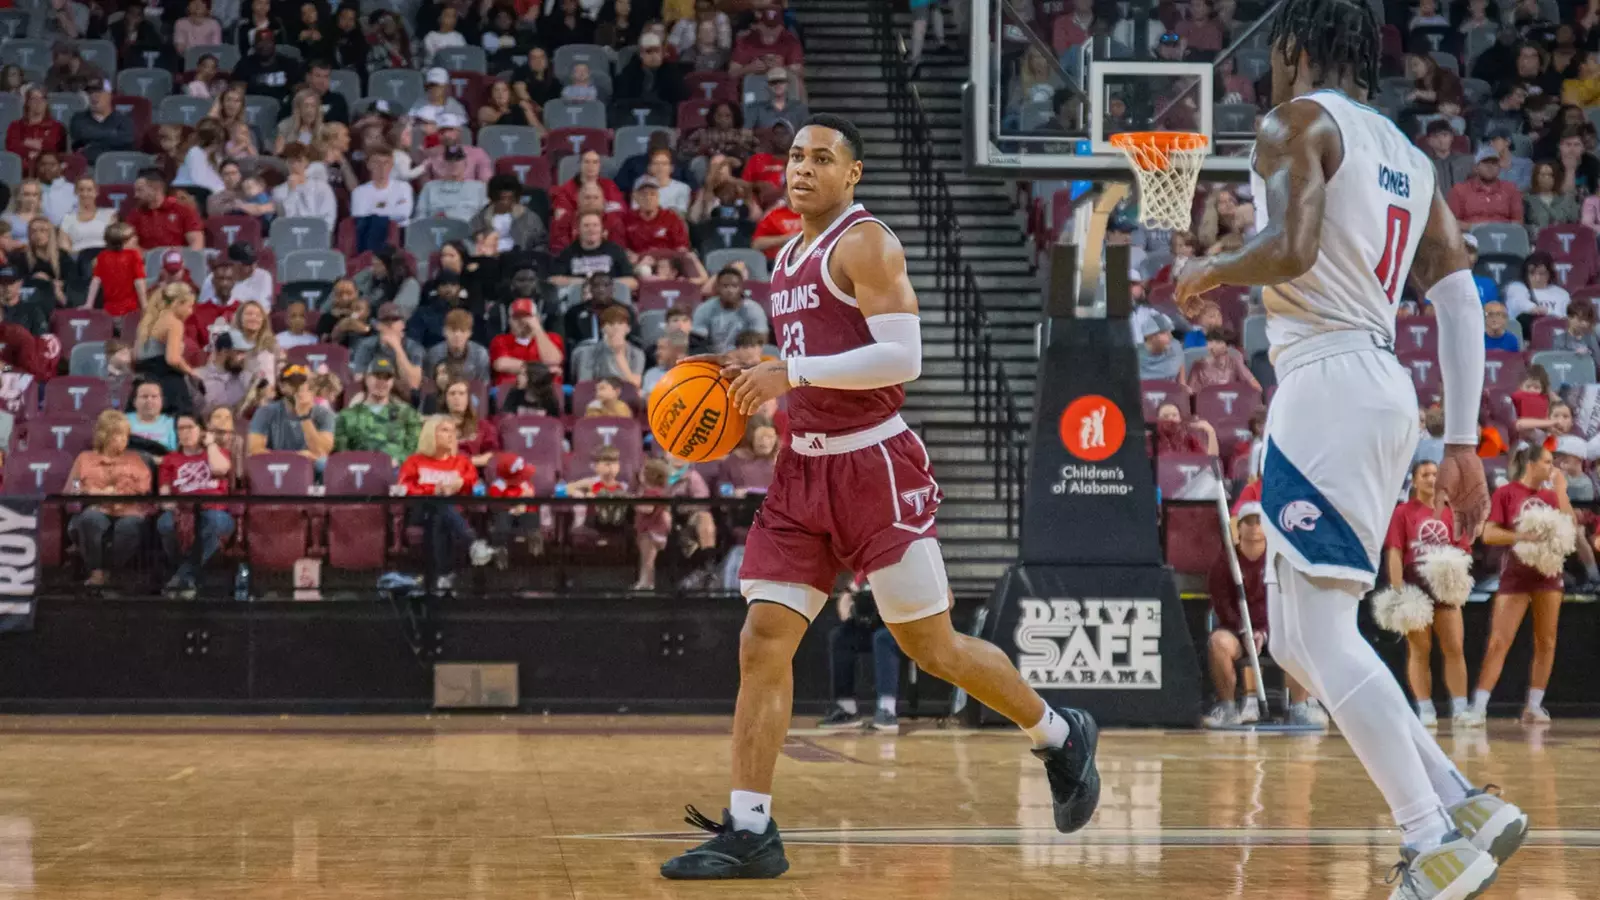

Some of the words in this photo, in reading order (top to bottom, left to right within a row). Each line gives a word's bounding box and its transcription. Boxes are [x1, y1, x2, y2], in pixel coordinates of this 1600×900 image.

[781, 321, 806, 360] 23
[678, 408, 721, 458] Wilson
[1062, 465, 1125, 480] Children's
[1052, 479, 1066, 494] of
[1070, 479, 1128, 495] Alabama
[1019, 598, 1161, 624] DRIVE
[1014, 623, 1161, 668] SAFE
[1028, 670, 1157, 684] ALABAMA
